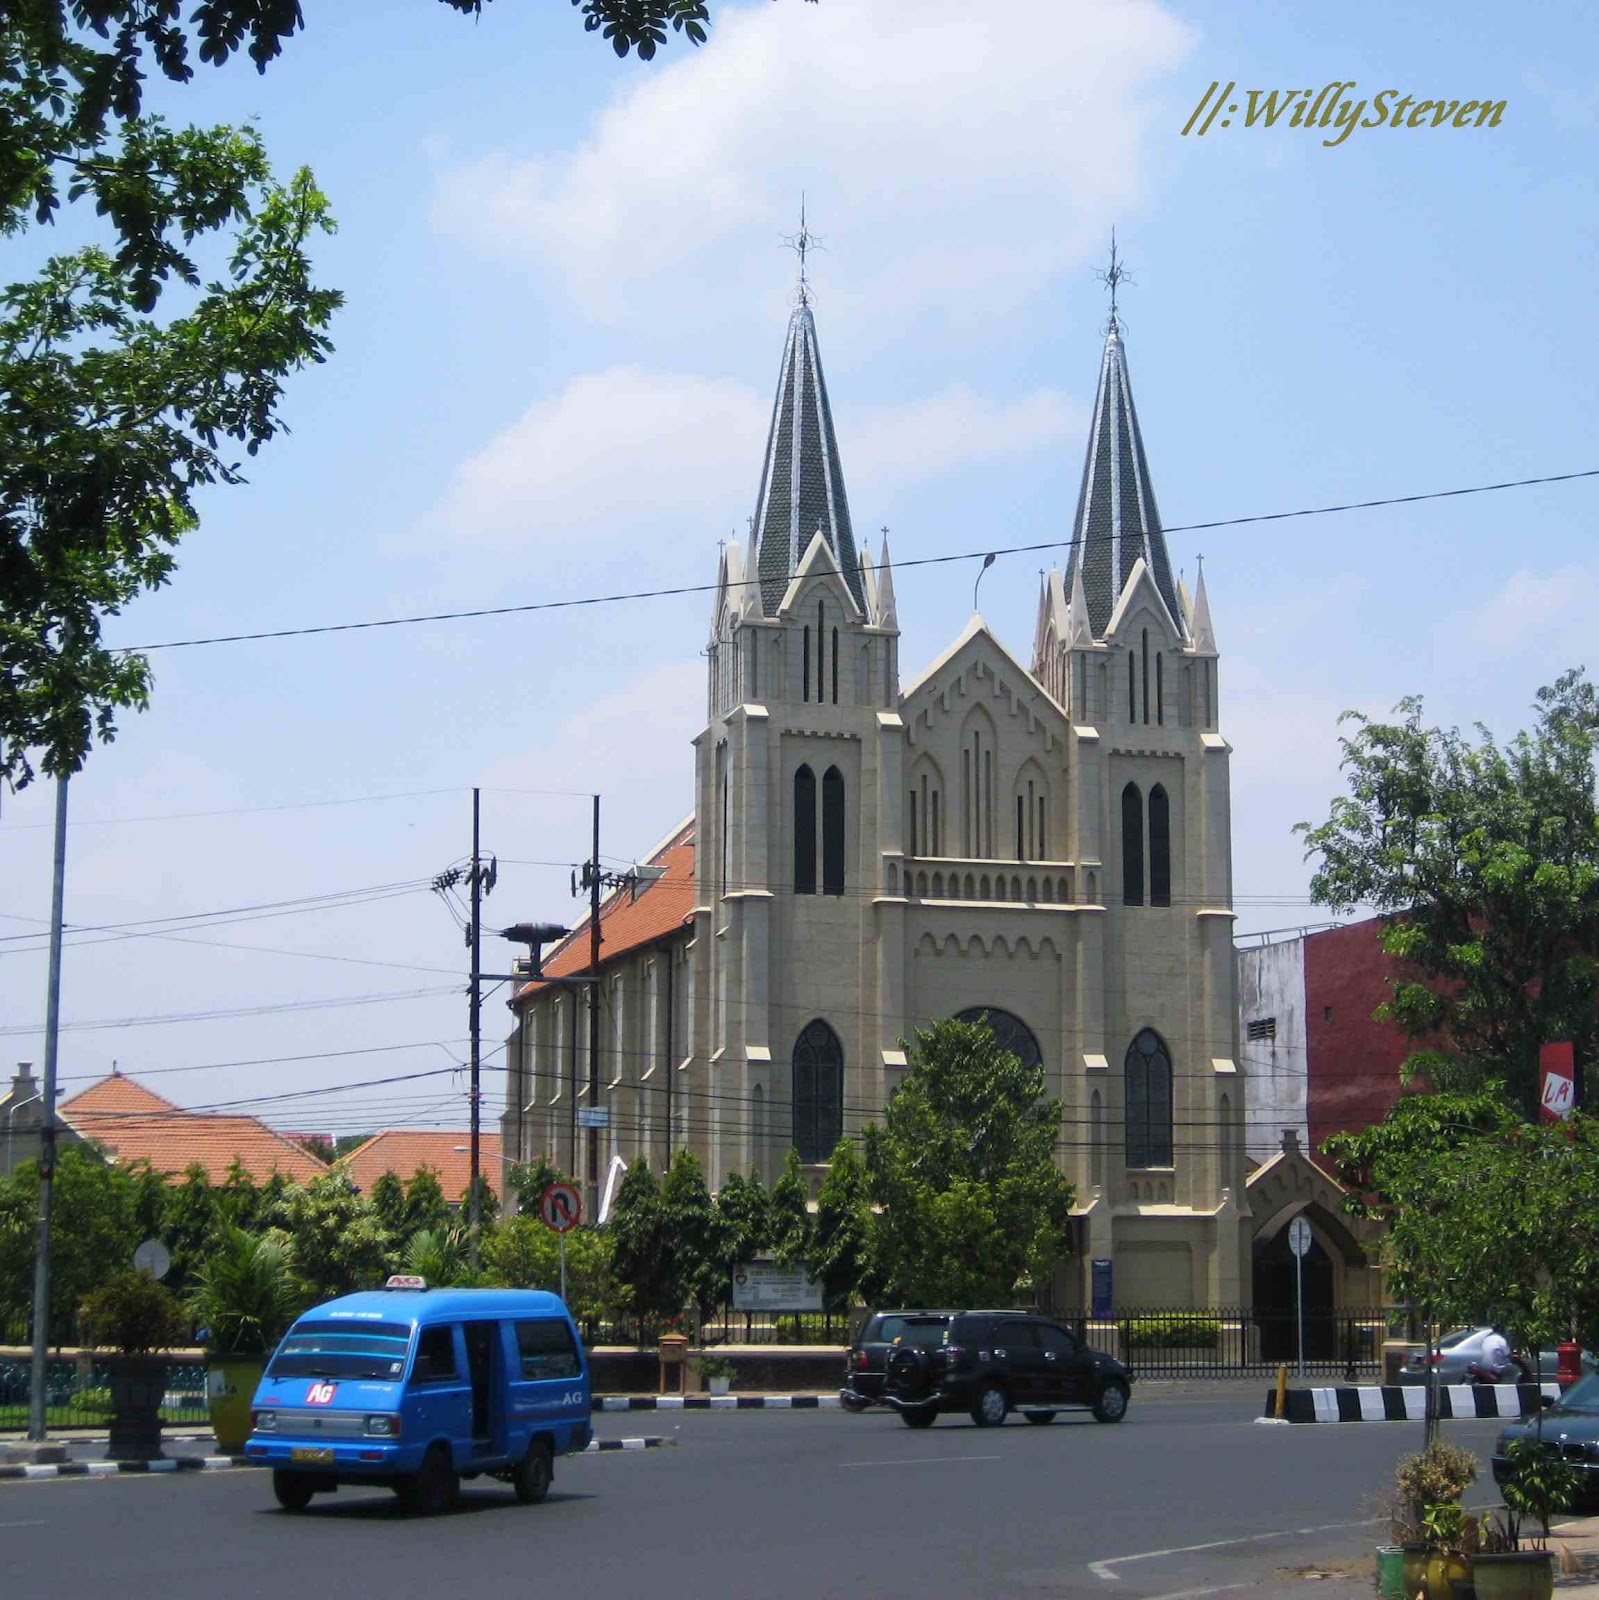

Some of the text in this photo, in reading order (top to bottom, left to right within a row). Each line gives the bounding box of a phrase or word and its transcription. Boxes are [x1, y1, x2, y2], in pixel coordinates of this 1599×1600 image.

[389, 1276, 421, 1286] AG
[306, 1383, 334, 1403] AG
[562, 1391, 583, 1405] AG
